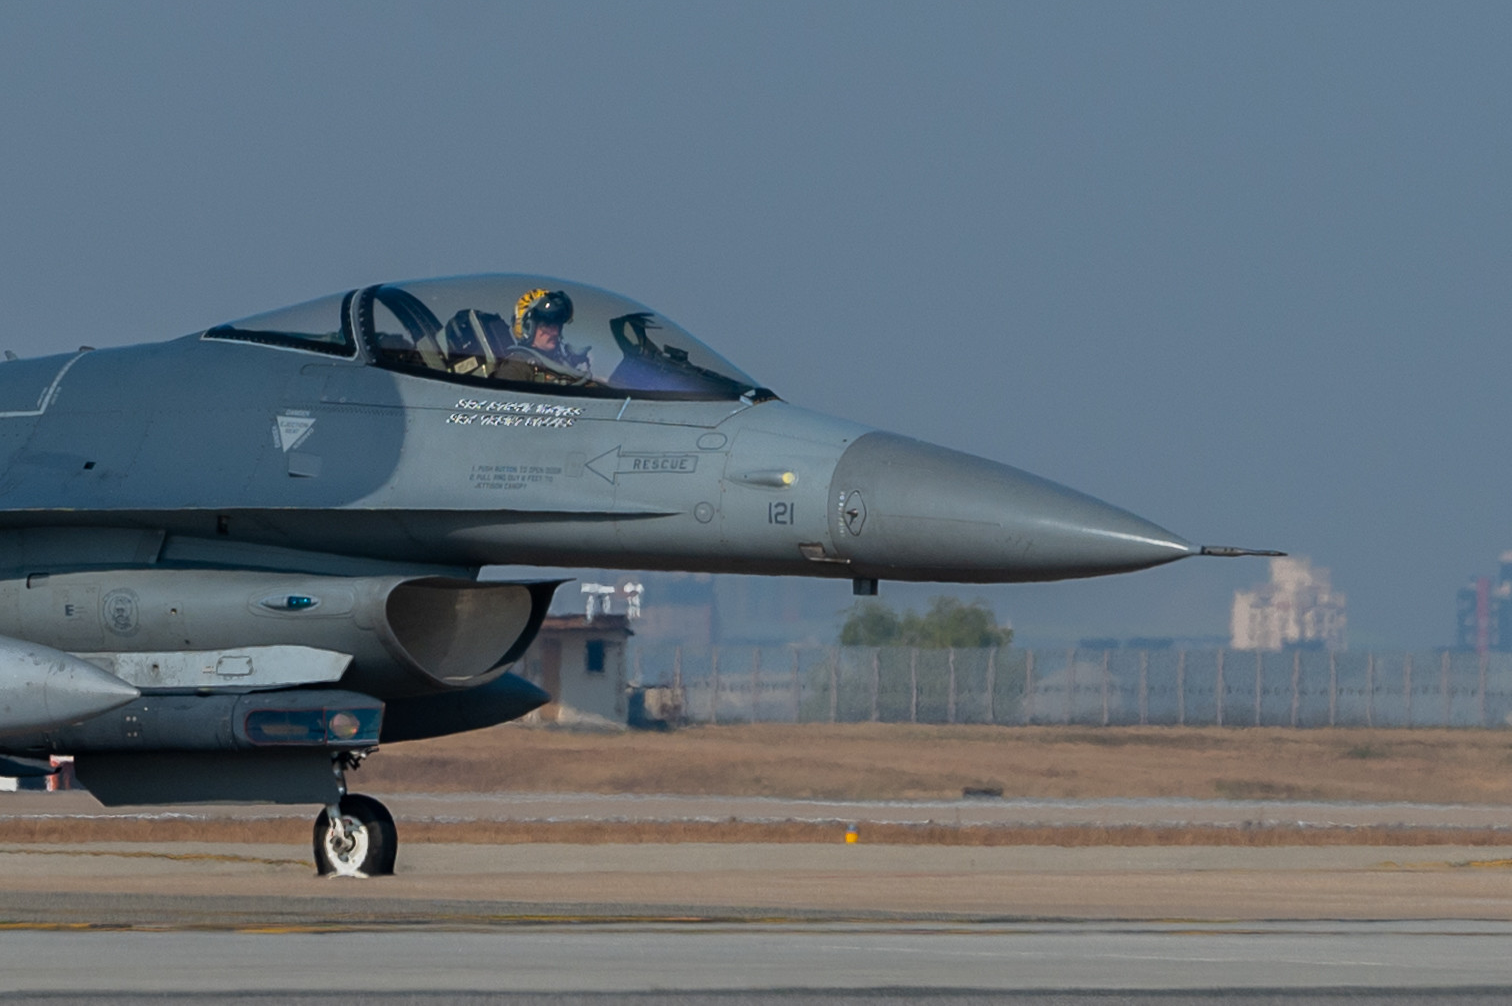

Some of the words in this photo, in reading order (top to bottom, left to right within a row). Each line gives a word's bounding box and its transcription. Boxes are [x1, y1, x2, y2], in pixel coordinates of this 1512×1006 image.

[632, 459, 688, 470] RESCUE
[768, 502, 794, 525] 121
[64, 604, 75, 616] E
